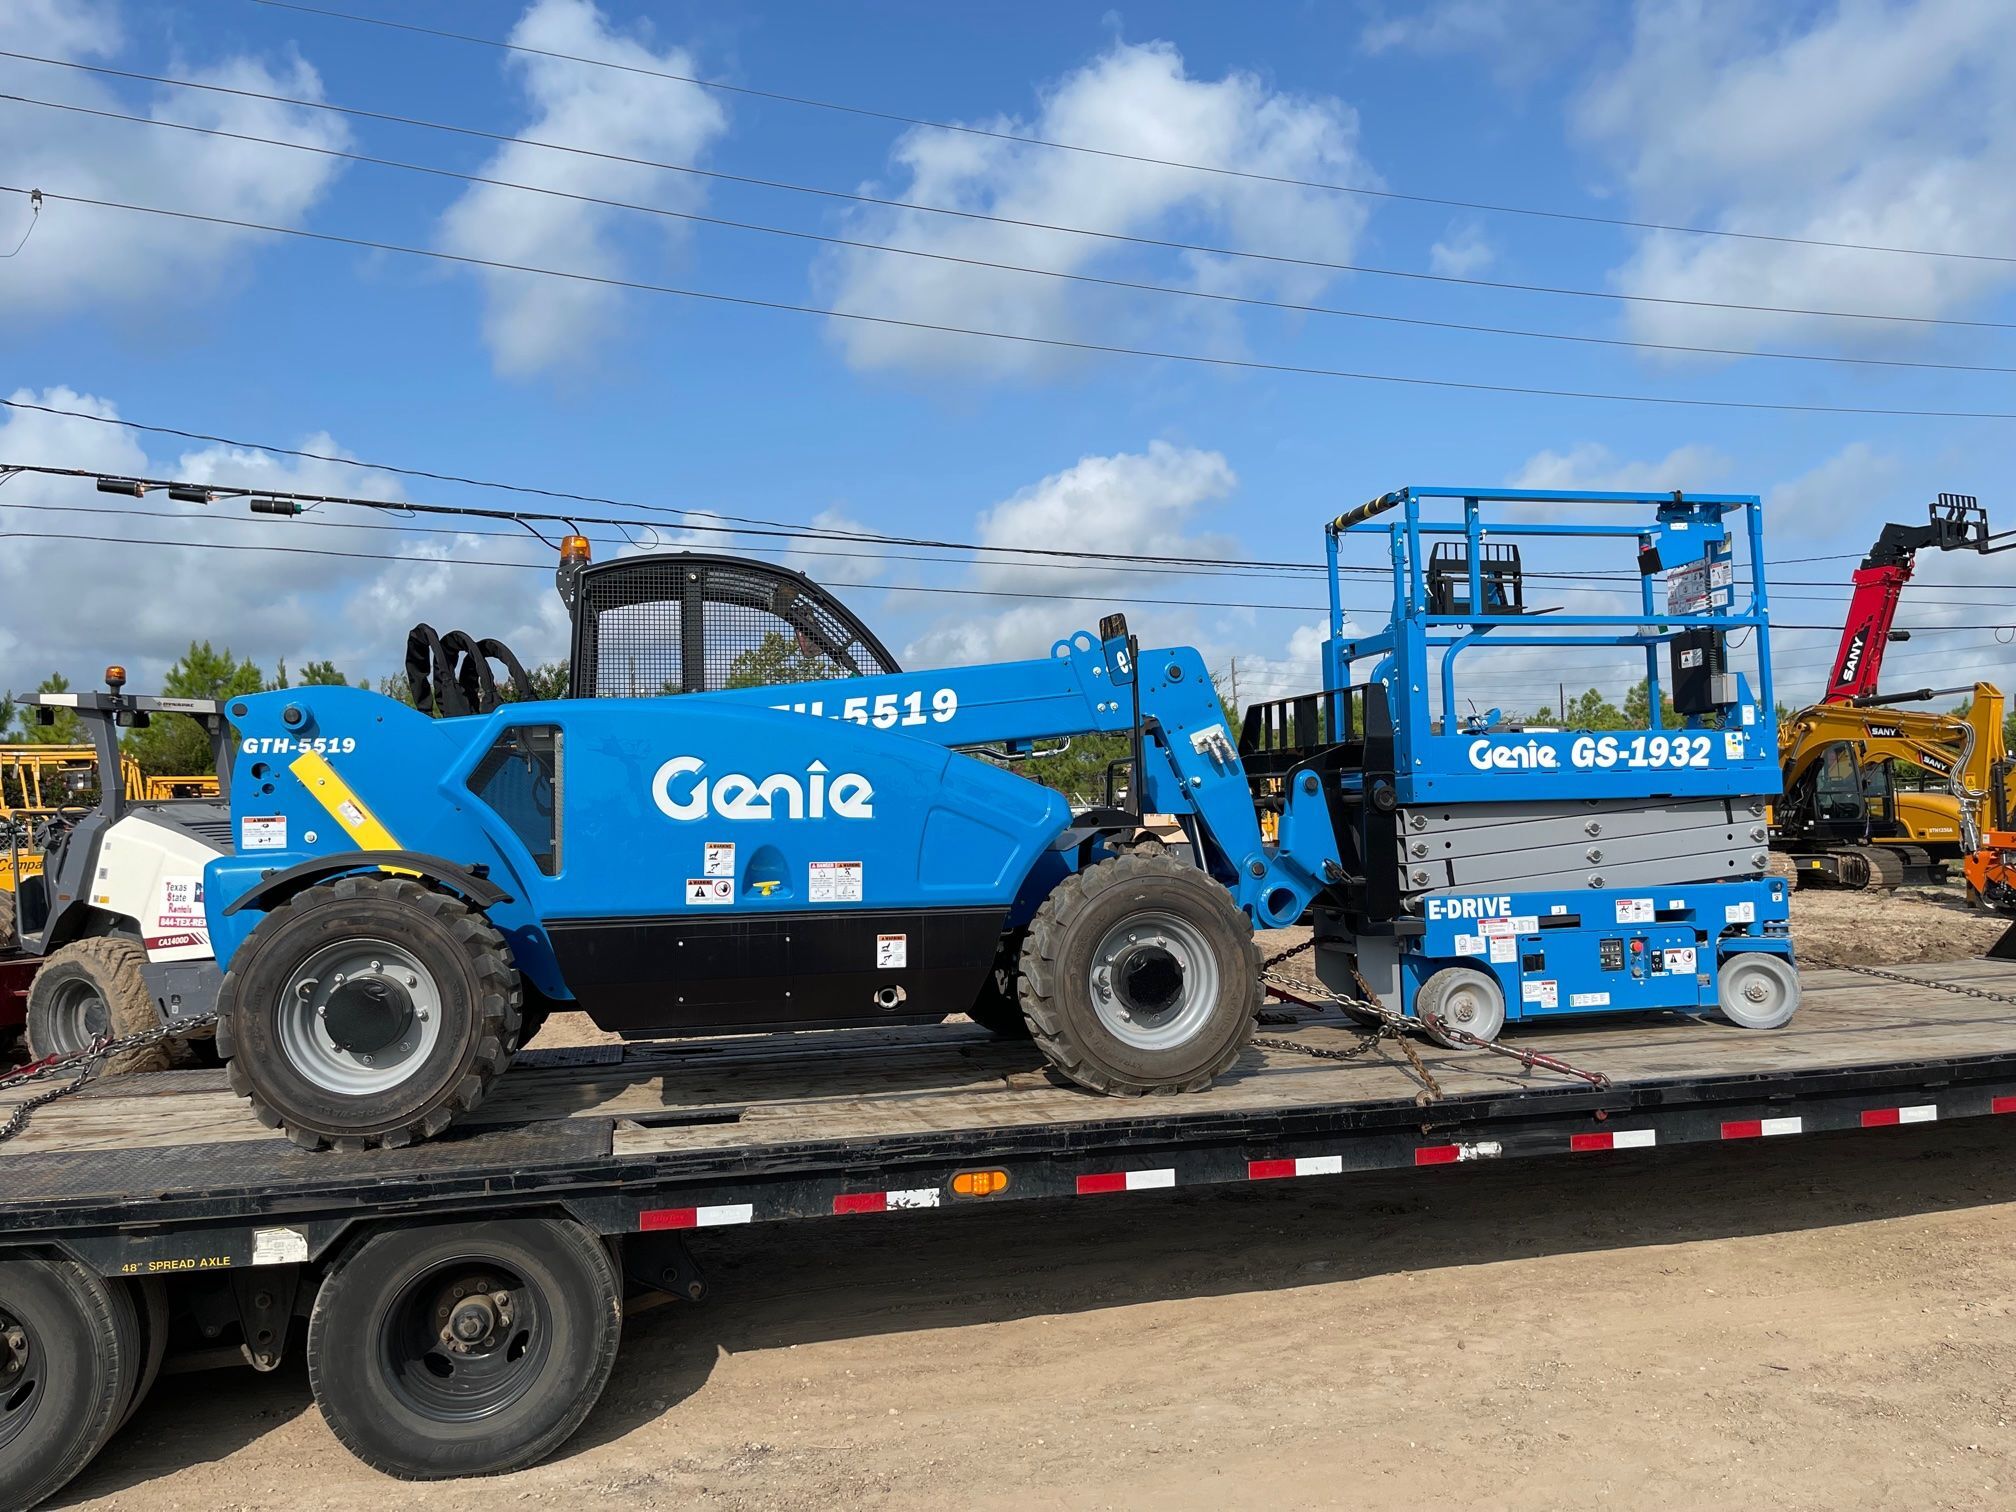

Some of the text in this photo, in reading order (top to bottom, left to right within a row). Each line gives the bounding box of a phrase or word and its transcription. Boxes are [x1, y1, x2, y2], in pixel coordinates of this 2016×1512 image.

[1843, 636, 1863, 681] SANY
[1871, 727, 1897, 736] SANY
[242, 737, 356, 755] GTH-5519
[1468, 736, 1711, 770] Genie GS-1932
[1923, 755, 1948, 770] SANY
[651, 756, 874, 821] Genie
[166, 882, 187, 892] Texas
[167, 892, 187, 902] State
[168, 903, 192, 914] Rentals
[1428, 896, 1512, 920] E-DRIVE
[158, 936, 190, 947] CA1400D
[122, 1256, 231, 1273] 48" SPREAD AXLE
